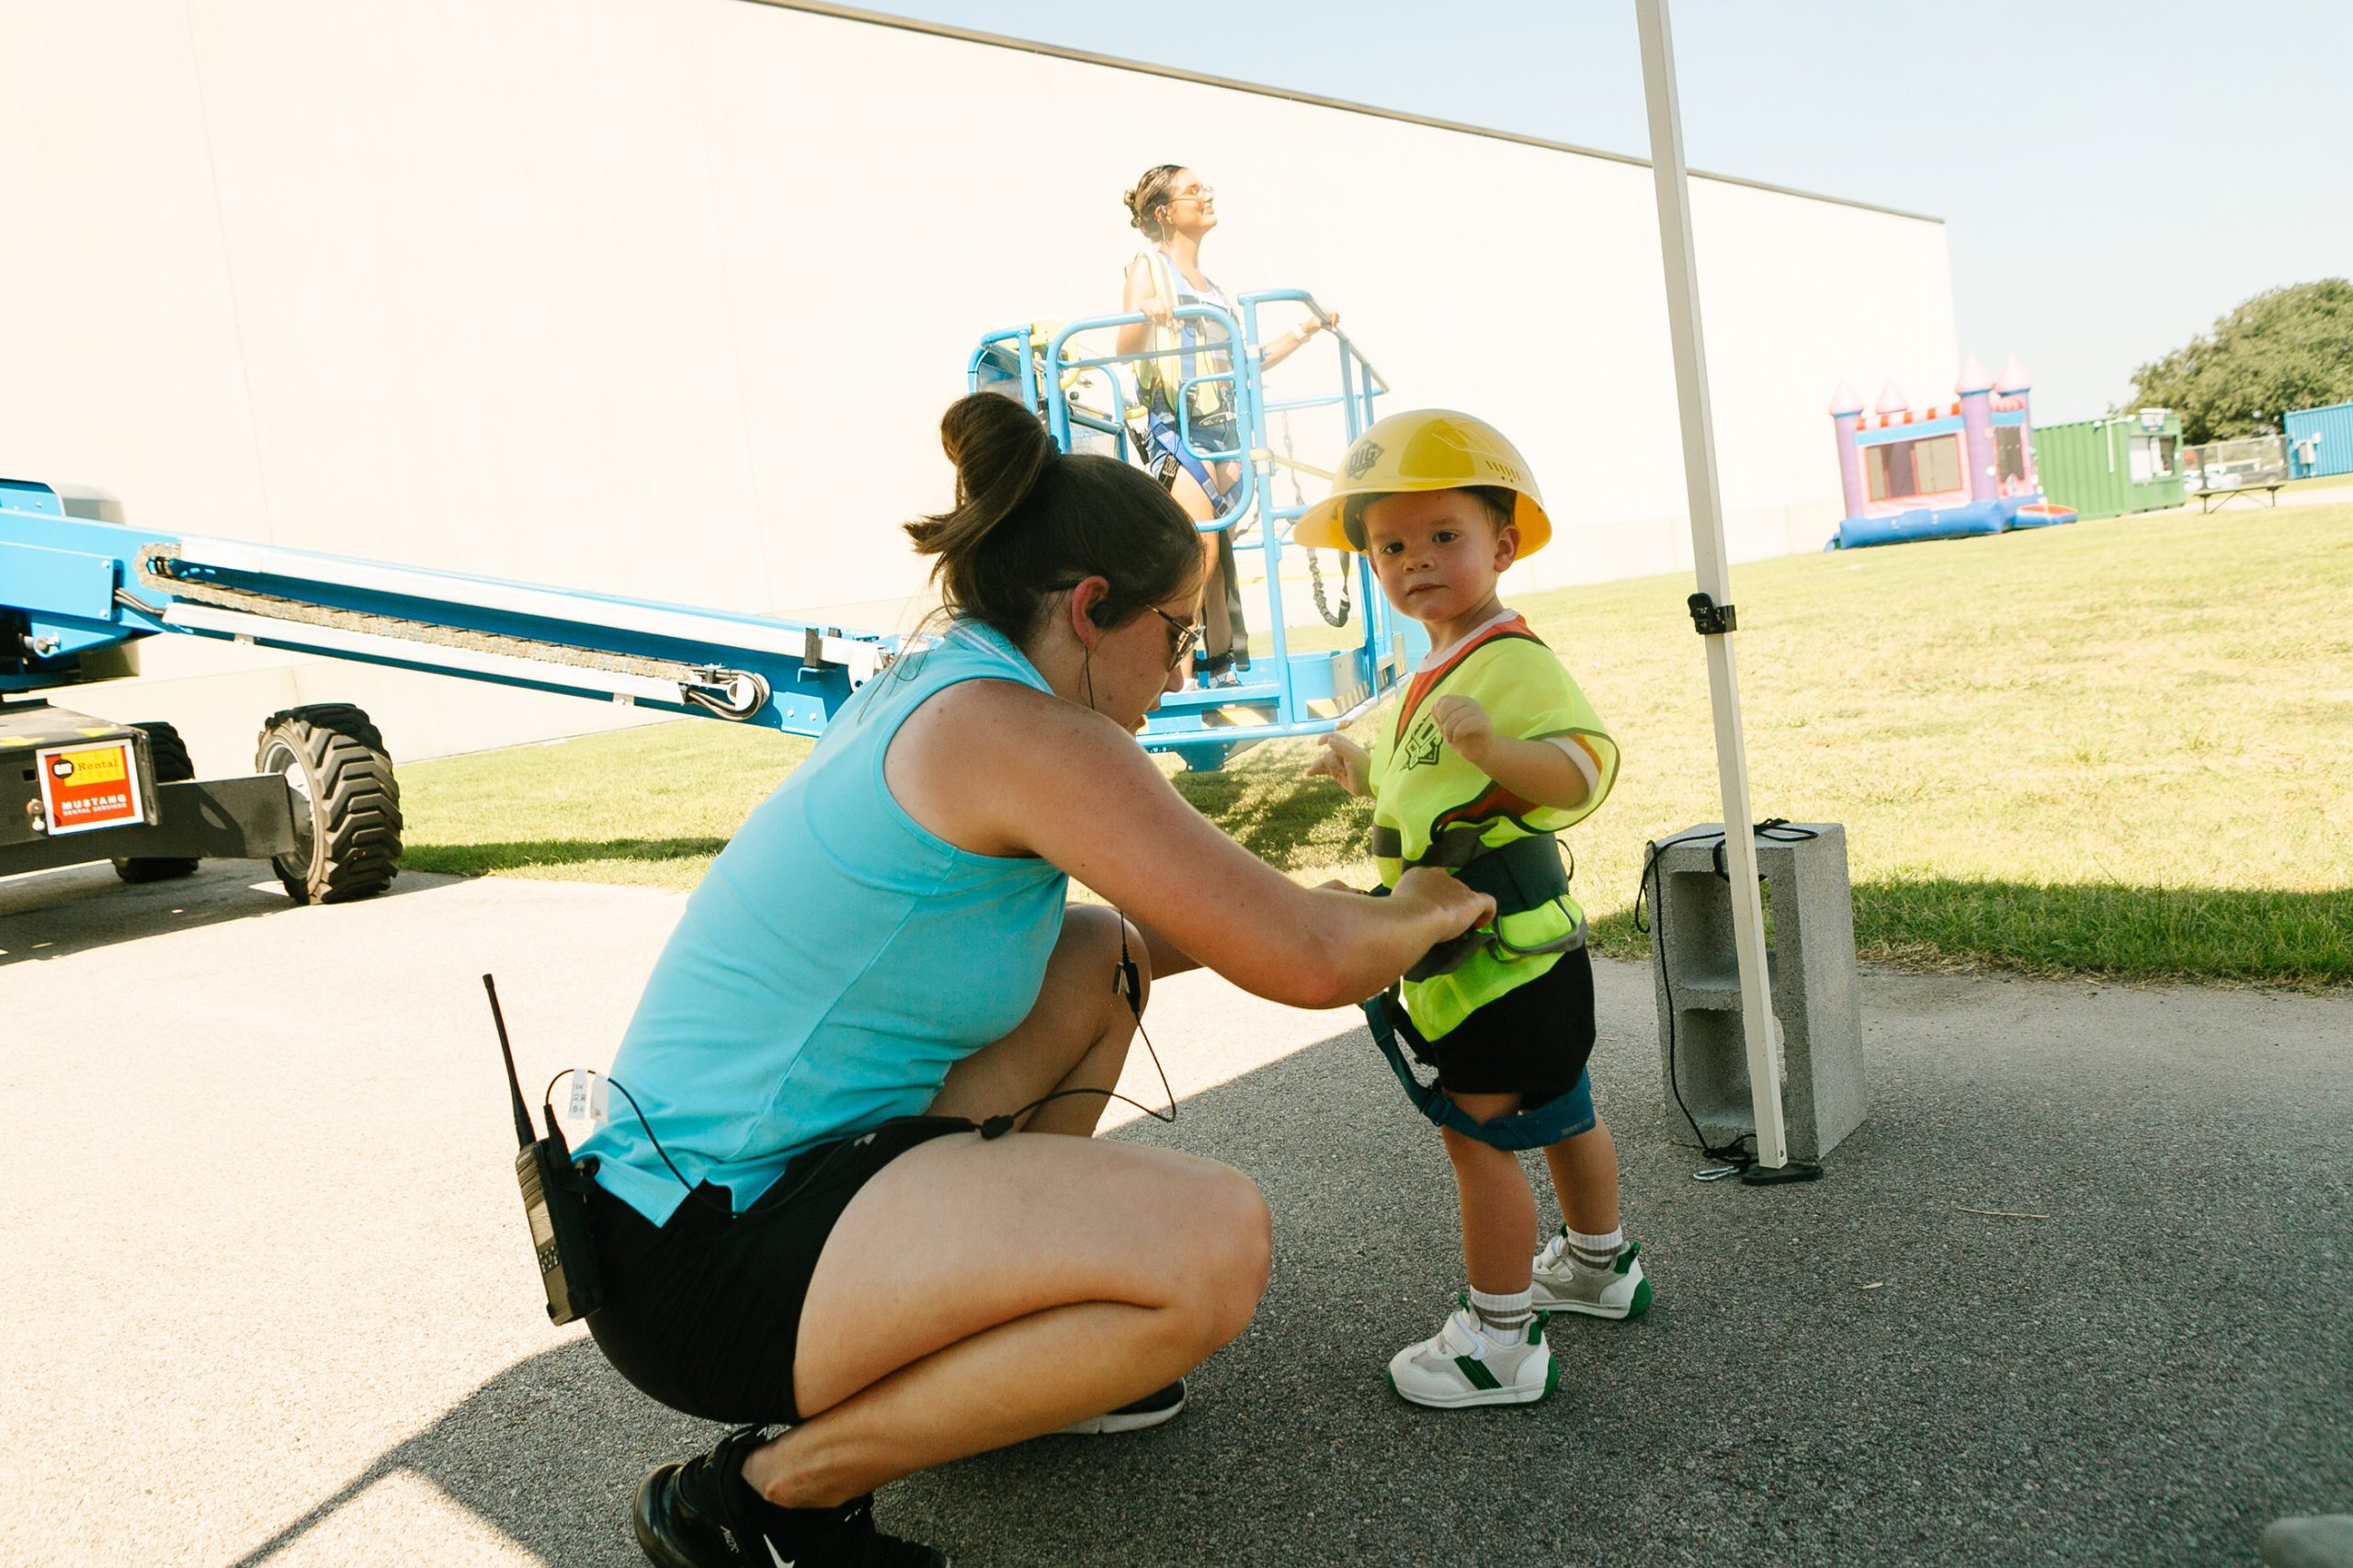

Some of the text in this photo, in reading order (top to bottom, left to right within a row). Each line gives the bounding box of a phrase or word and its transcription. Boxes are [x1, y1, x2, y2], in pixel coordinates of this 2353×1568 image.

[1348, 443, 1380, 470] DIG
[77, 759, 118, 771] Rental
[61, 794, 127, 810] MUSTANG
